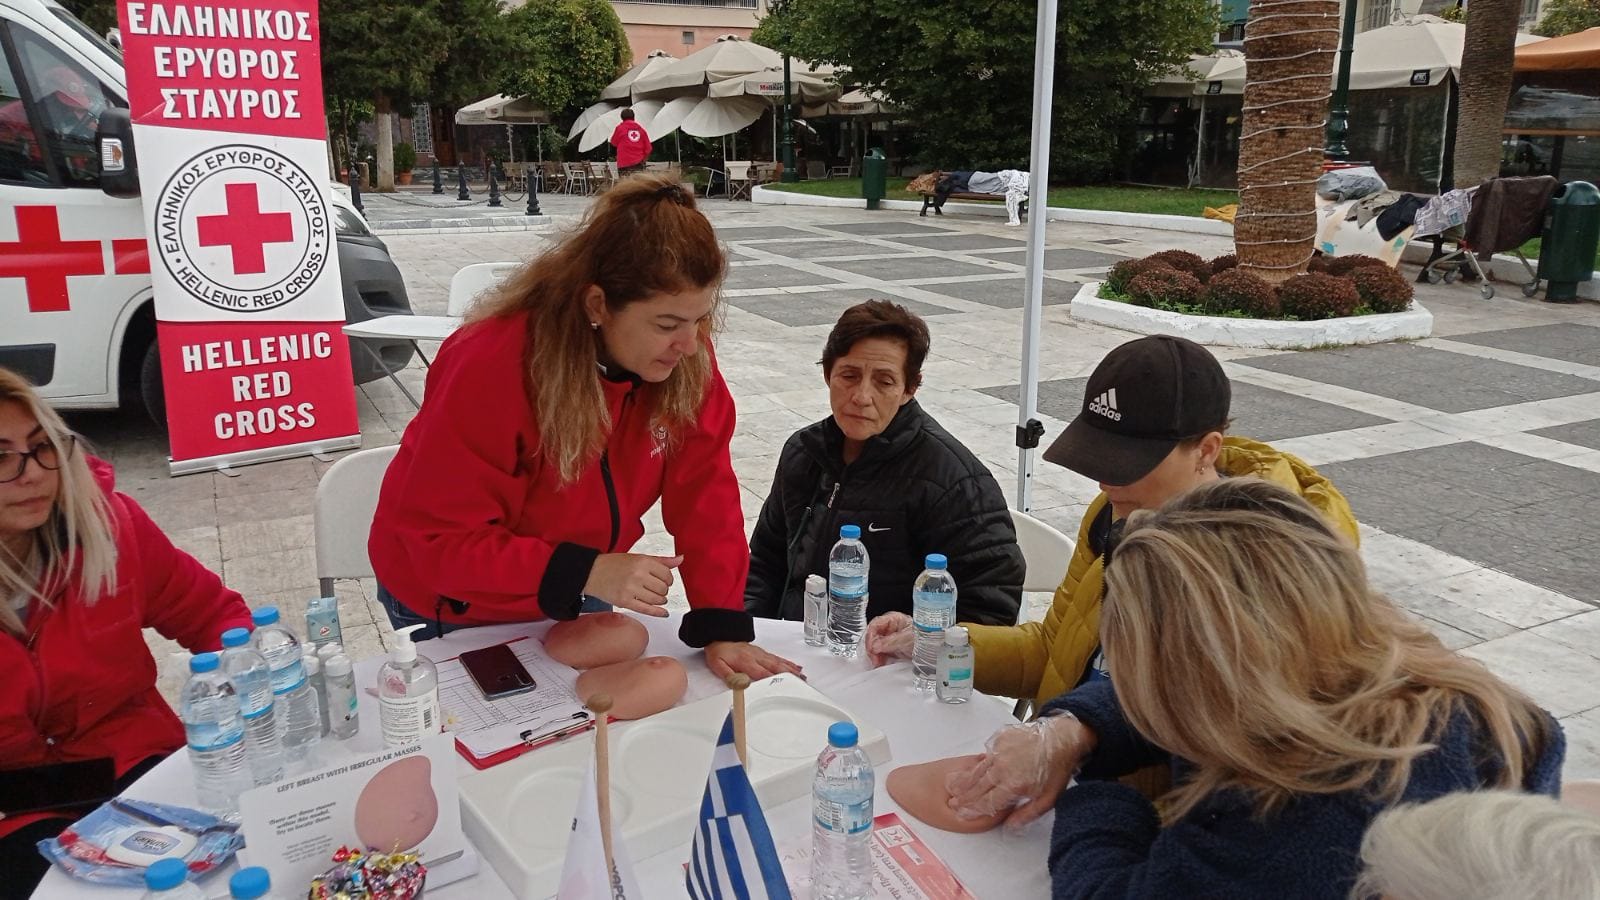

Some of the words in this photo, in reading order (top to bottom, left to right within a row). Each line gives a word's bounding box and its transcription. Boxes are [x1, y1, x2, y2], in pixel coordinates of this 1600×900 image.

[126, 2, 312, 41] ΕΛΛΗΝΙΚΟΣ
[153, 46, 300, 80] ΕΡΥΘΡΟΣ
[160, 88, 301, 119] ΣΤΑΥΡΟΣ
[162, 164, 205, 254] ΕΛΛΗΝΙΚΟΣ
[204, 151, 287, 176] ΕΡΥΘΡΟΣ
[286, 171, 324, 238] ΣΤΑΥΡΟΣ
[176, 266, 249, 308] HELLENIC
[253, 289, 285, 308] RED
[285, 252, 322, 295] CROSS
[181, 332, 332, 373] HELLENIC
[231, 371, 291, 402] RED
[214, 402, 316, 440] CROSS
[1088, 401, 1122, 422] adidas
[276, 781, 295, 793] LEFT
[296, 771, 325, 788] BREAST
[326, 766, 349, 778] WITH
[350, 752, 392, 771] IRREGULAR
[393, 744, 423, 758] MASSES
